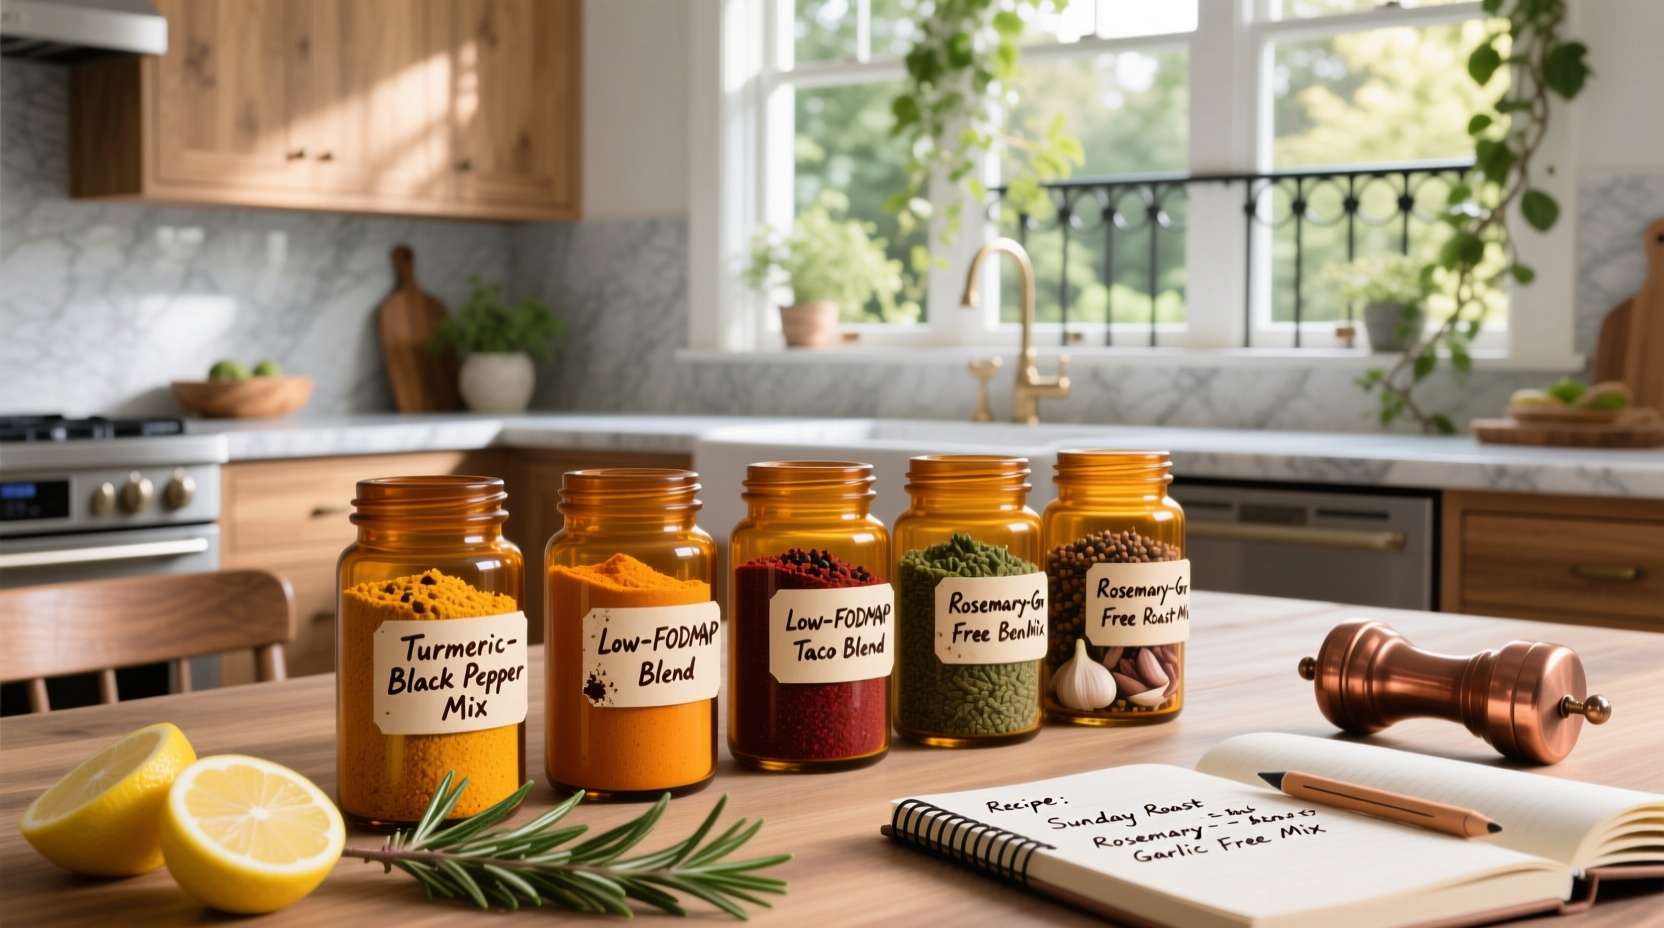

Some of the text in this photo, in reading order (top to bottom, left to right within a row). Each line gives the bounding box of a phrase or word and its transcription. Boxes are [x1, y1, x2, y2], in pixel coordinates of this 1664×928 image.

[785, 603, 891, 631] Low-FODMAP
[1101, 606, 1136, 628] Free
[1143, 606, 1176, 626] Roast
[401, 633, 517, 661] Turmeric-
[597, 620, 719, 655] Low-FODMAP
[793, 632, 885, 662] Taco Blend
[952, 622, 991, 643] Free
[387, 662, 524, 695] Black Pepper
[638, 656, 696, 687] Blend
[441, 694, 488, 721] Mix
[985, 796, 1069, 814] Recipe:
[1047, 811, 1137, 830] Sunday
[1143, 798, 1205, 817] Roast
[1133, 824, 1326, 862] Garlic Free Mix
